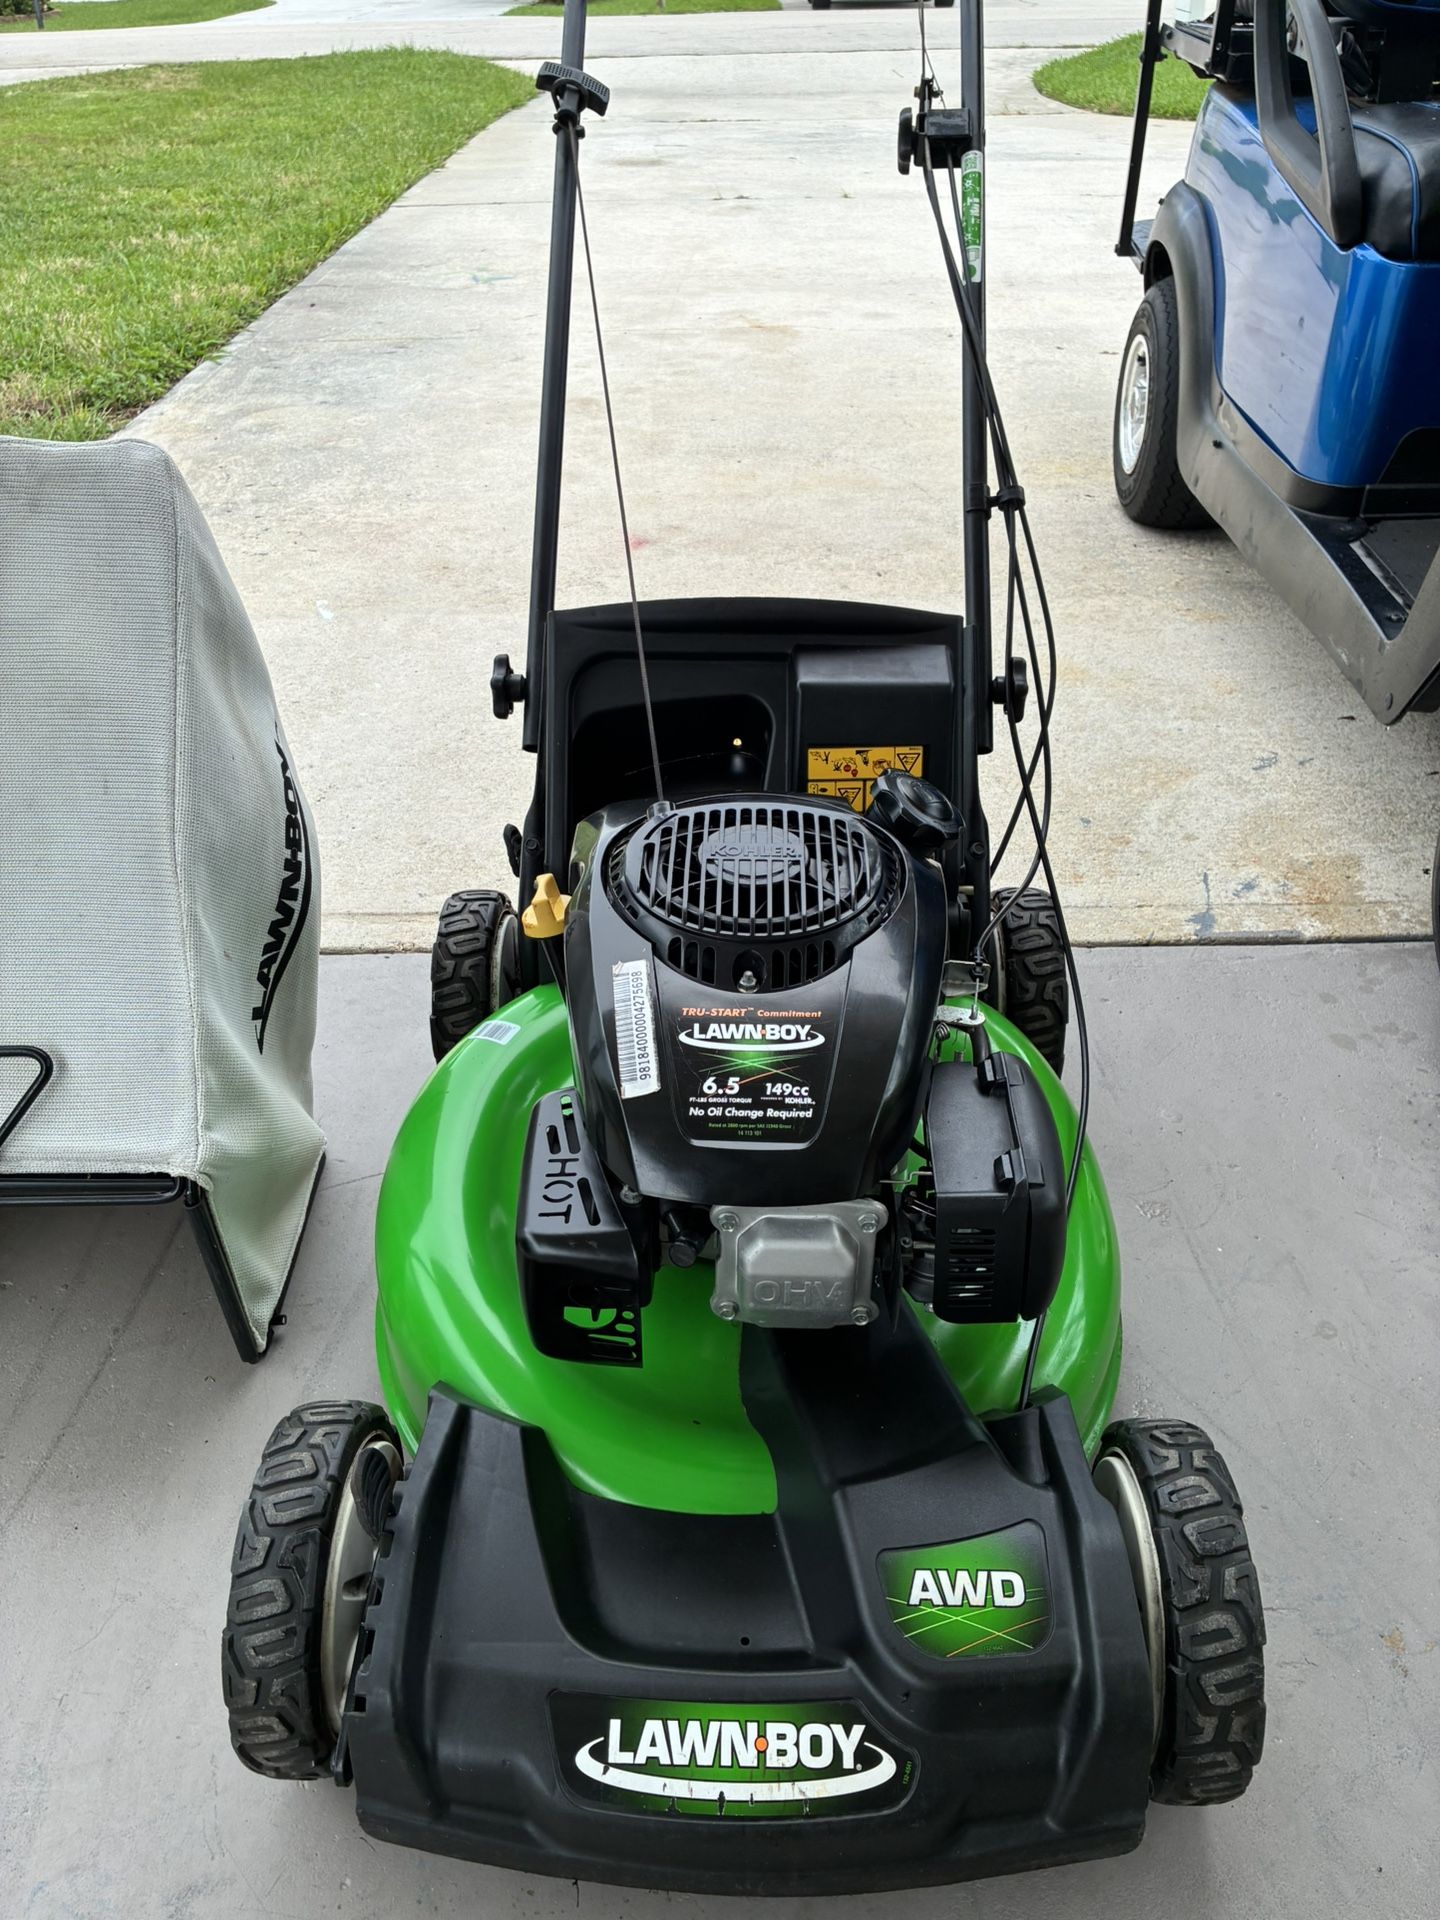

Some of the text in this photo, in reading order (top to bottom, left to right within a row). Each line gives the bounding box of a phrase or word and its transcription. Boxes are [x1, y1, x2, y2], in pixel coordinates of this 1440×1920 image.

[682, 1007, 822, 1018] TRU-START Commitment
[631, 970, 651, 1081] 98184000004275698
[702, 1076, 740, 1095] 6.5
[765, 1082, 810, 1096] 149cc
[689, 1106, 813, 1120] No Oil Change Required
[538, 1157, 580, 1224] HOT
[754, 1280, 842, 1305] OHV
[907, 1568, 1026, 1607] AWD
